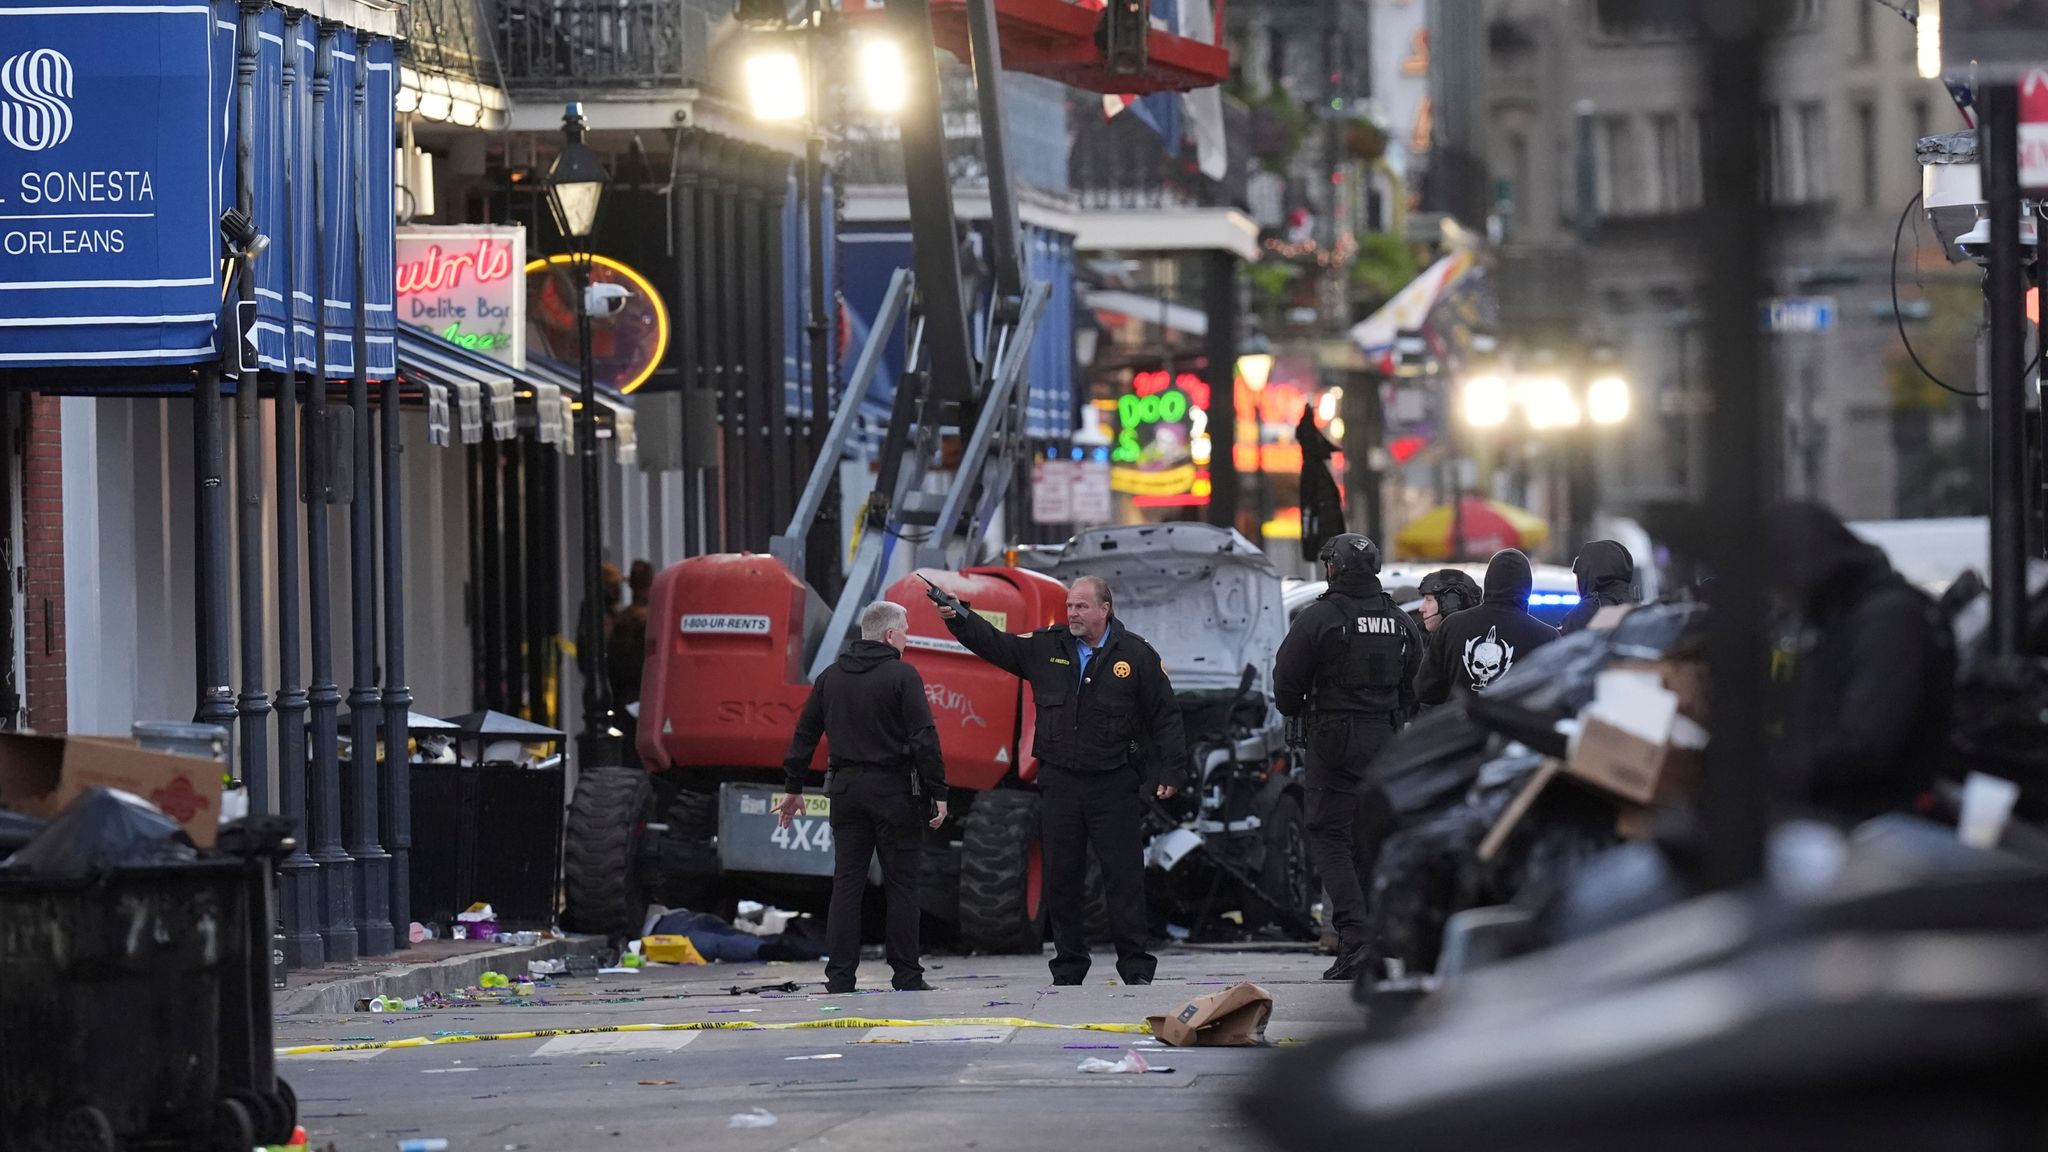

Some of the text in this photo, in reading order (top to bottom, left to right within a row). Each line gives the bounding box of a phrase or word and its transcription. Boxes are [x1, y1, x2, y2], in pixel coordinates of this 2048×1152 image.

[20, 170, 154, 203] SONESTA
[4, 229, 125, 255] ORLEANS
[411, 296, 511, 318] Delite Bar
[683, 618, 768, 630] 1-800-UR-RENTS
[1357, 616, 1396, 634] SWAT
[770, 818, 832, 853] 4X4
